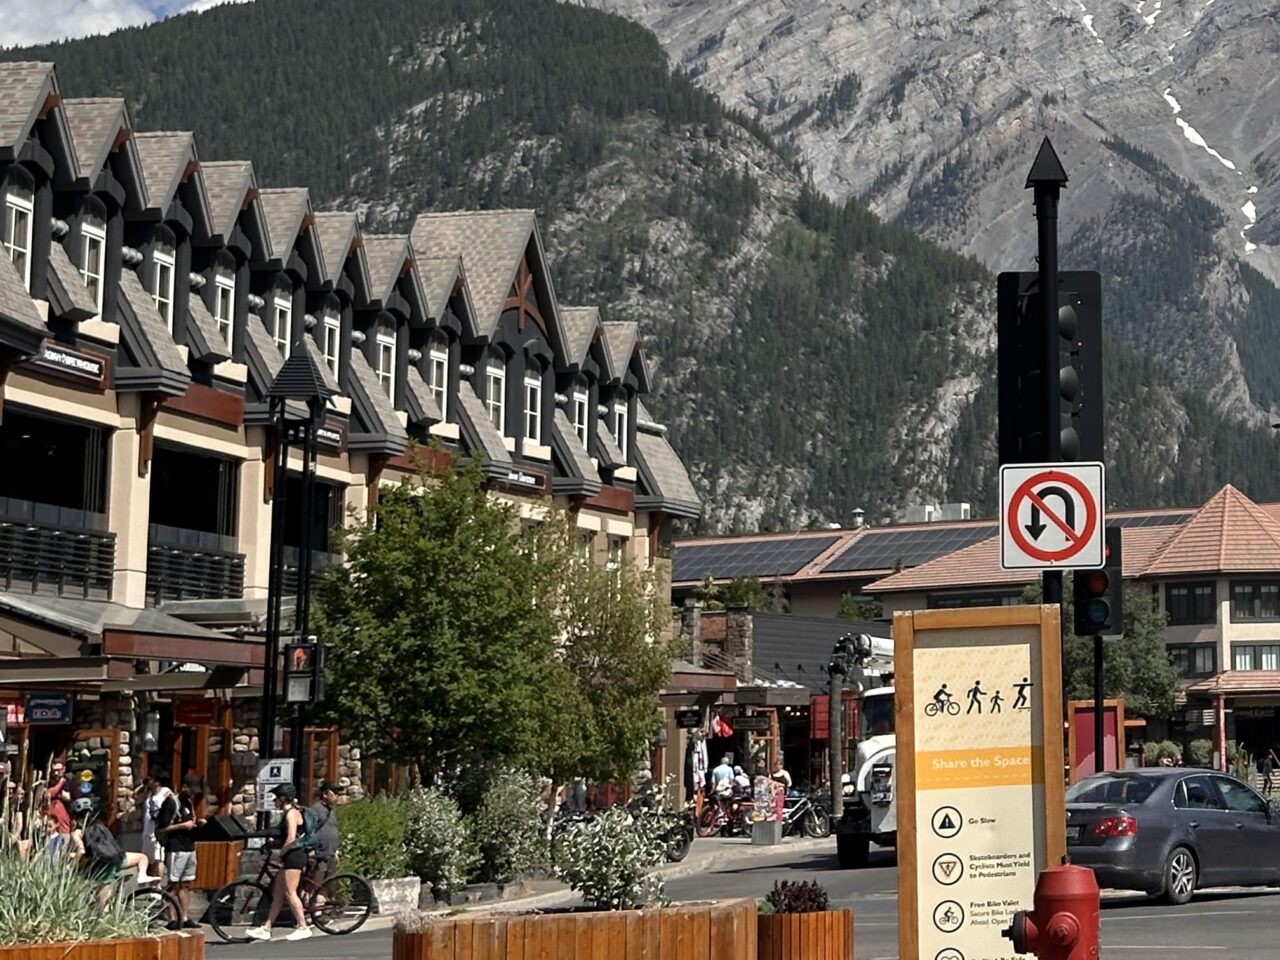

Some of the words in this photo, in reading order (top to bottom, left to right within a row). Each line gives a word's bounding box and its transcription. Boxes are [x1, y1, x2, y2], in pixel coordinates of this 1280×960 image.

[932, 758, 967, 769] Share
[970, 756, 990, 768] the
[994, 755, 1030, 768] Space
[969, 853, 1017, 861] Skateboarders
[1018, 851, 1031, 859] and
[996, 861, 1012, 869] Must
[1013, 860, 1030, 868] Yield
[978, 870, 1016, 878] Pedestrians
[987, 900, 1001, 908] Bike
[1002, 899, 1019, 907] Valet
